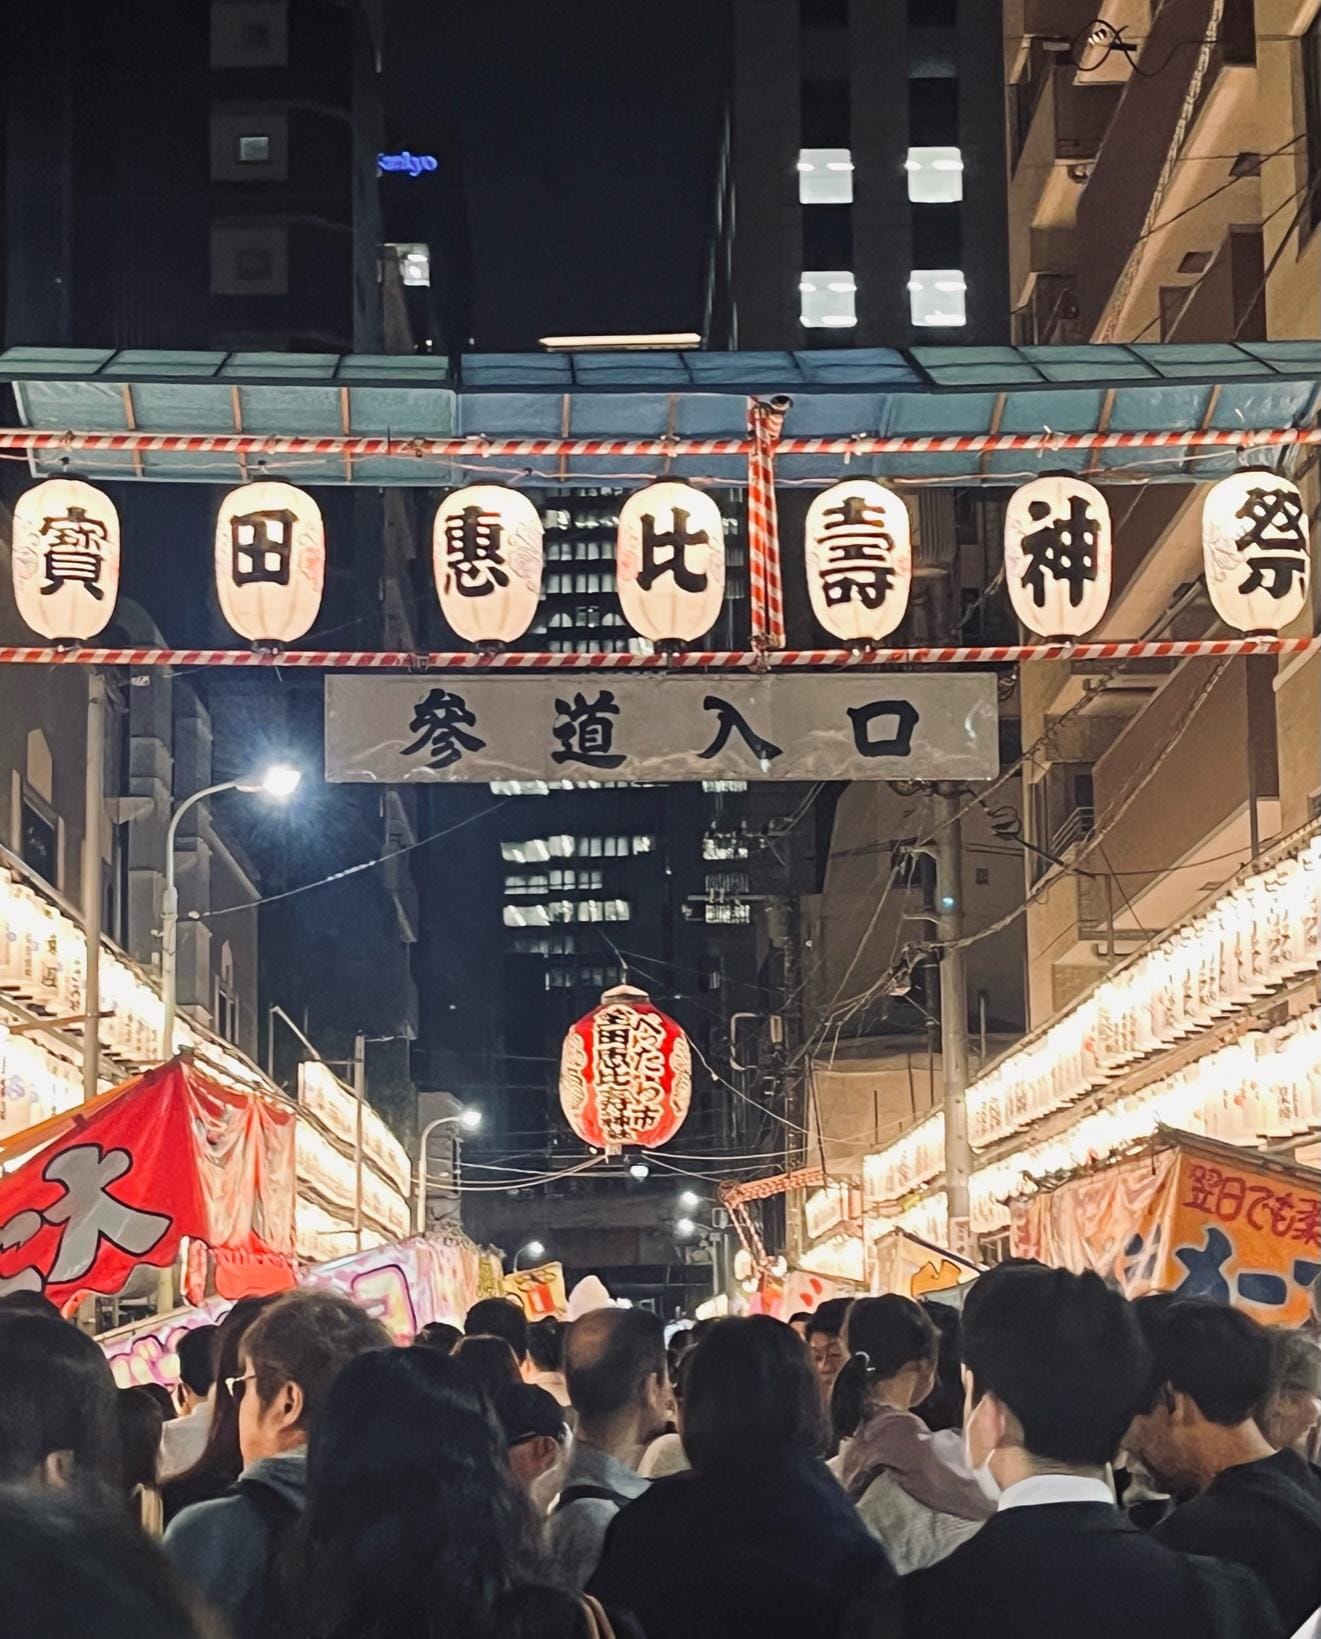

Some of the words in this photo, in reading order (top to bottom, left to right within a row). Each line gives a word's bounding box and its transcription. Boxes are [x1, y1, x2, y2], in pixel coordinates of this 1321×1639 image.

[231, 508, 299, 586] 田
[636, 506, 708, 593] 比
[1021, 495, 1101, 608] 神
[1235, 487, 1306, 600] 祭
